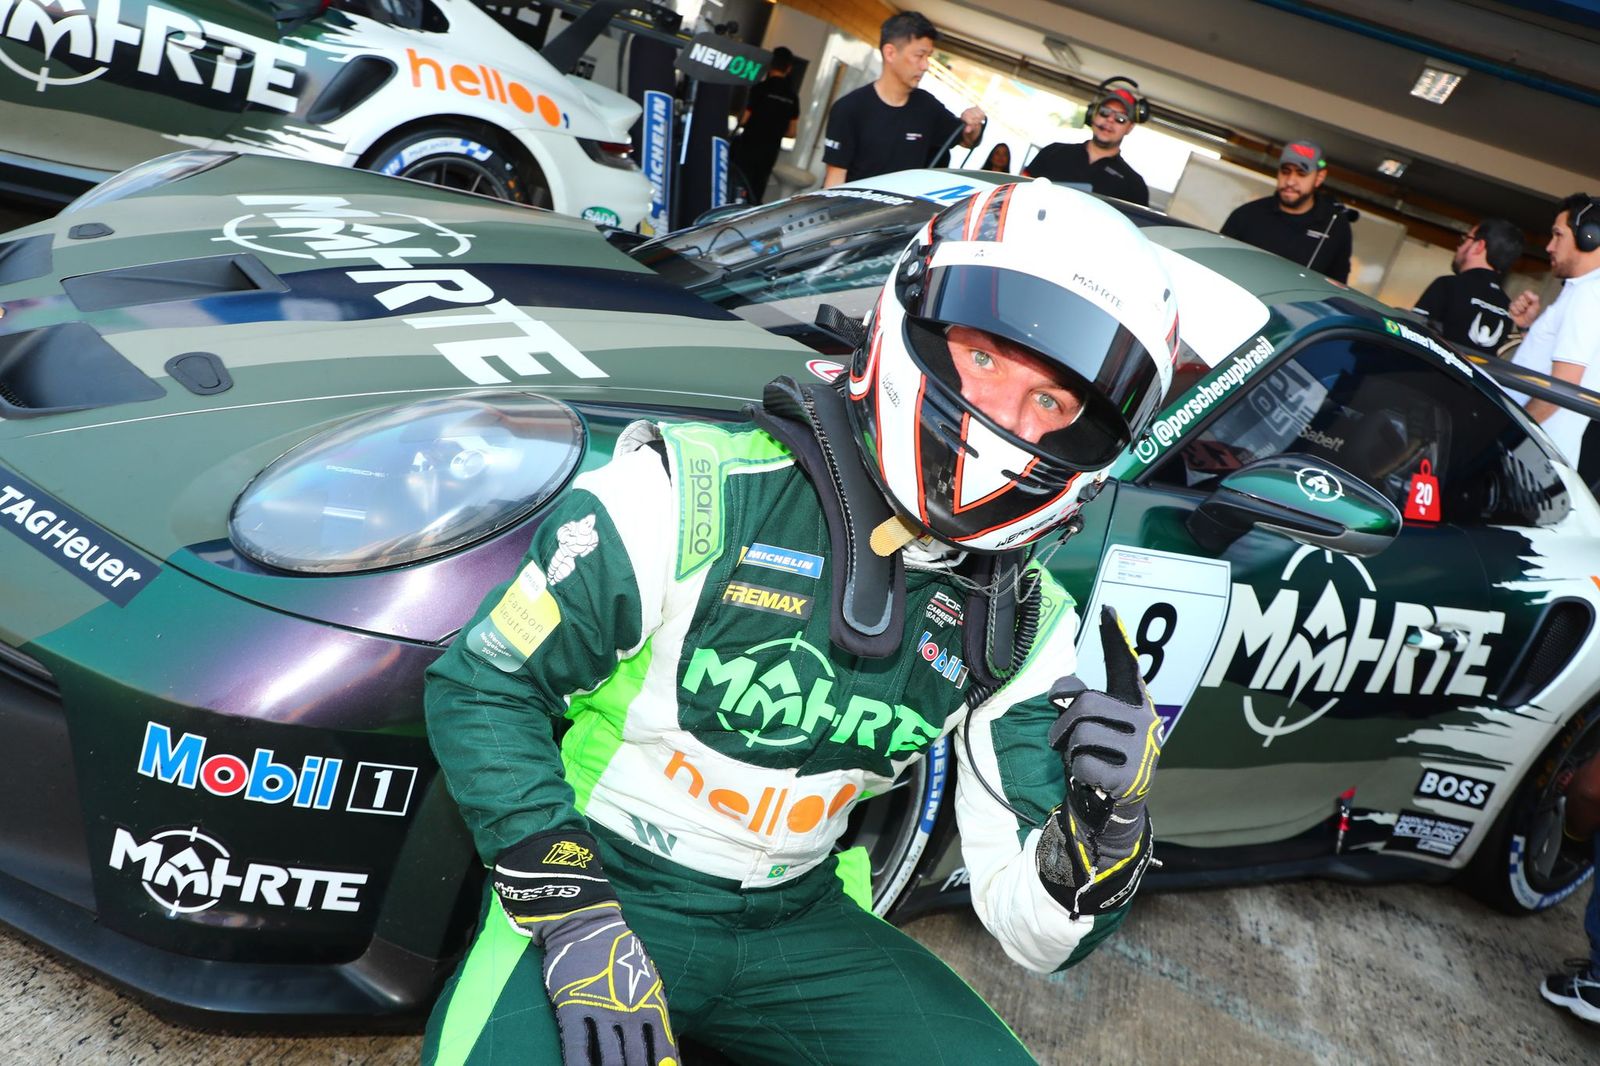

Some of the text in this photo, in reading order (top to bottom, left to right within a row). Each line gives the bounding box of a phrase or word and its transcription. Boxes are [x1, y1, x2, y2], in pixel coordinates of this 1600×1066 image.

[584, 208, 617, 227] SADA
[1152, 335, 1275, 447] @porschecupbrasil
[1299, 424, 1344, 452] Sabelt
[690, 459, 712, 555] sparco
[1415, 482, 1433, 506] 20
[746, 549, 815, 570] MICHELIN
[722, 584, 807, 615] FREMAX
[926, 604, 957, 627] CARRERA
[138, 720, 343, 810] Mobil
[1419, 771, 1489, 805] BOSS
